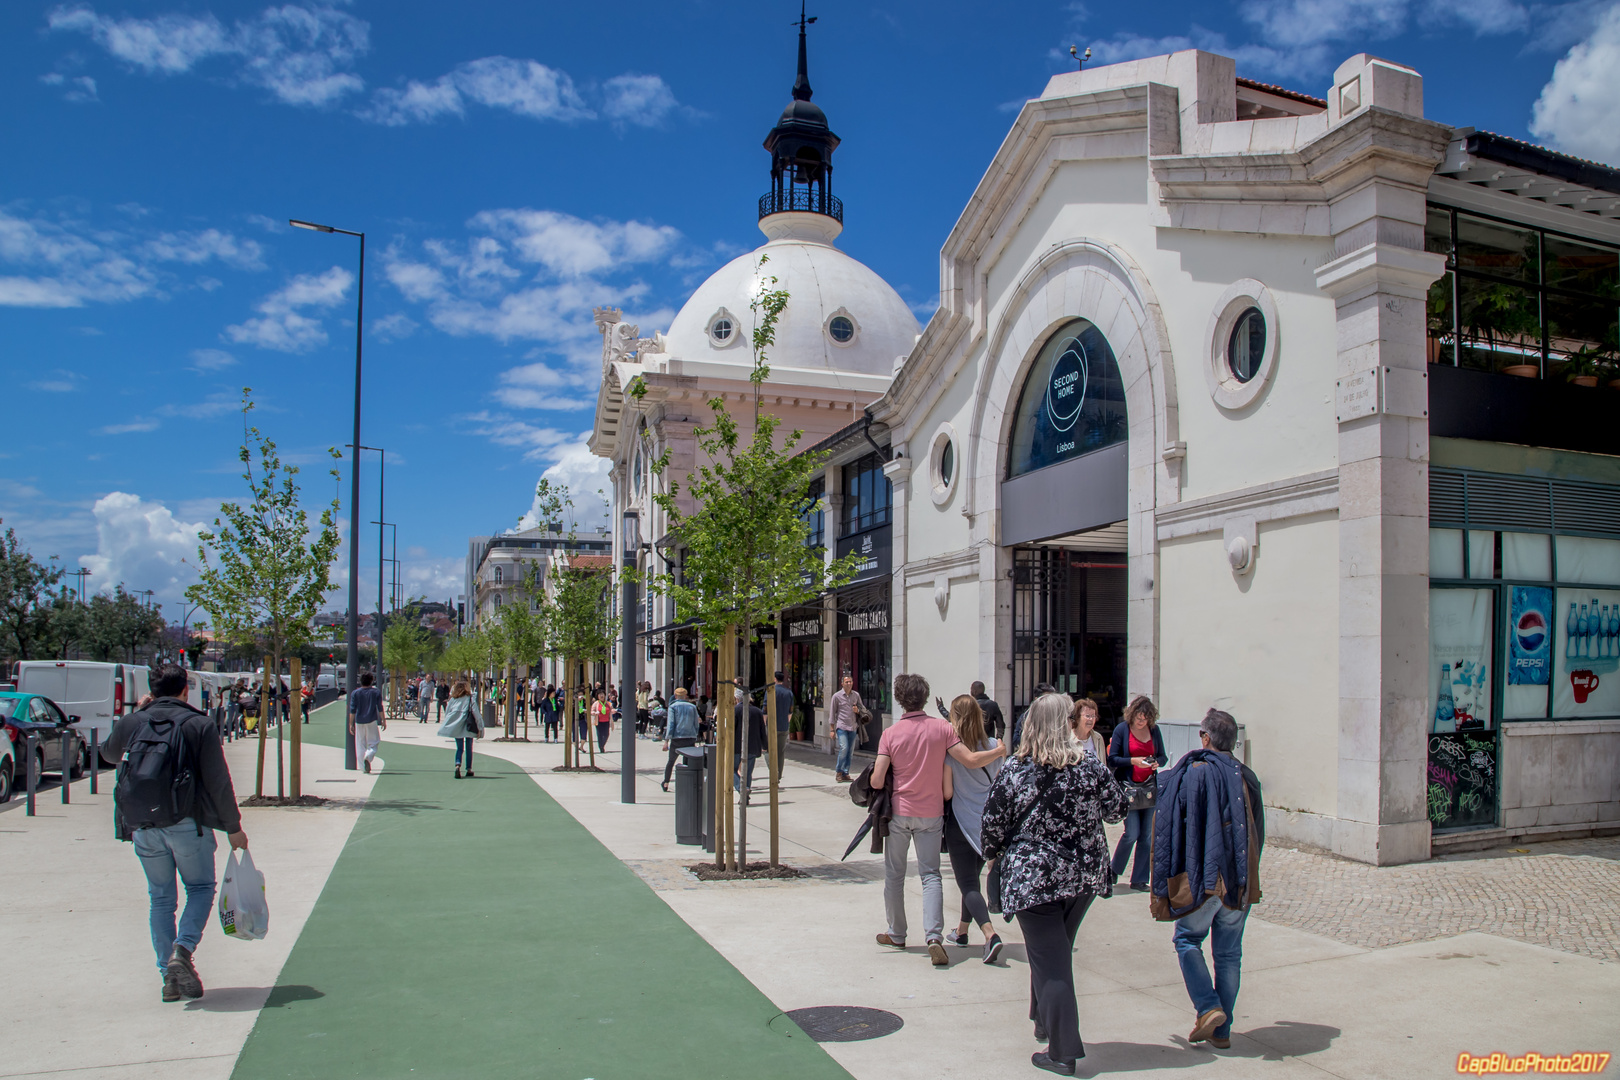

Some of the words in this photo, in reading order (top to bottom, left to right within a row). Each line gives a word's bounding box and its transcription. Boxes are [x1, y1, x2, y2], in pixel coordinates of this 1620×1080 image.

[1054, 371, 1078, 389] SECOND
[1057, 383, 1075, 399] HOME
[1056, 441, 1075, 454] Lisboa
[1515, 658, 1545, 668] PEPSI
